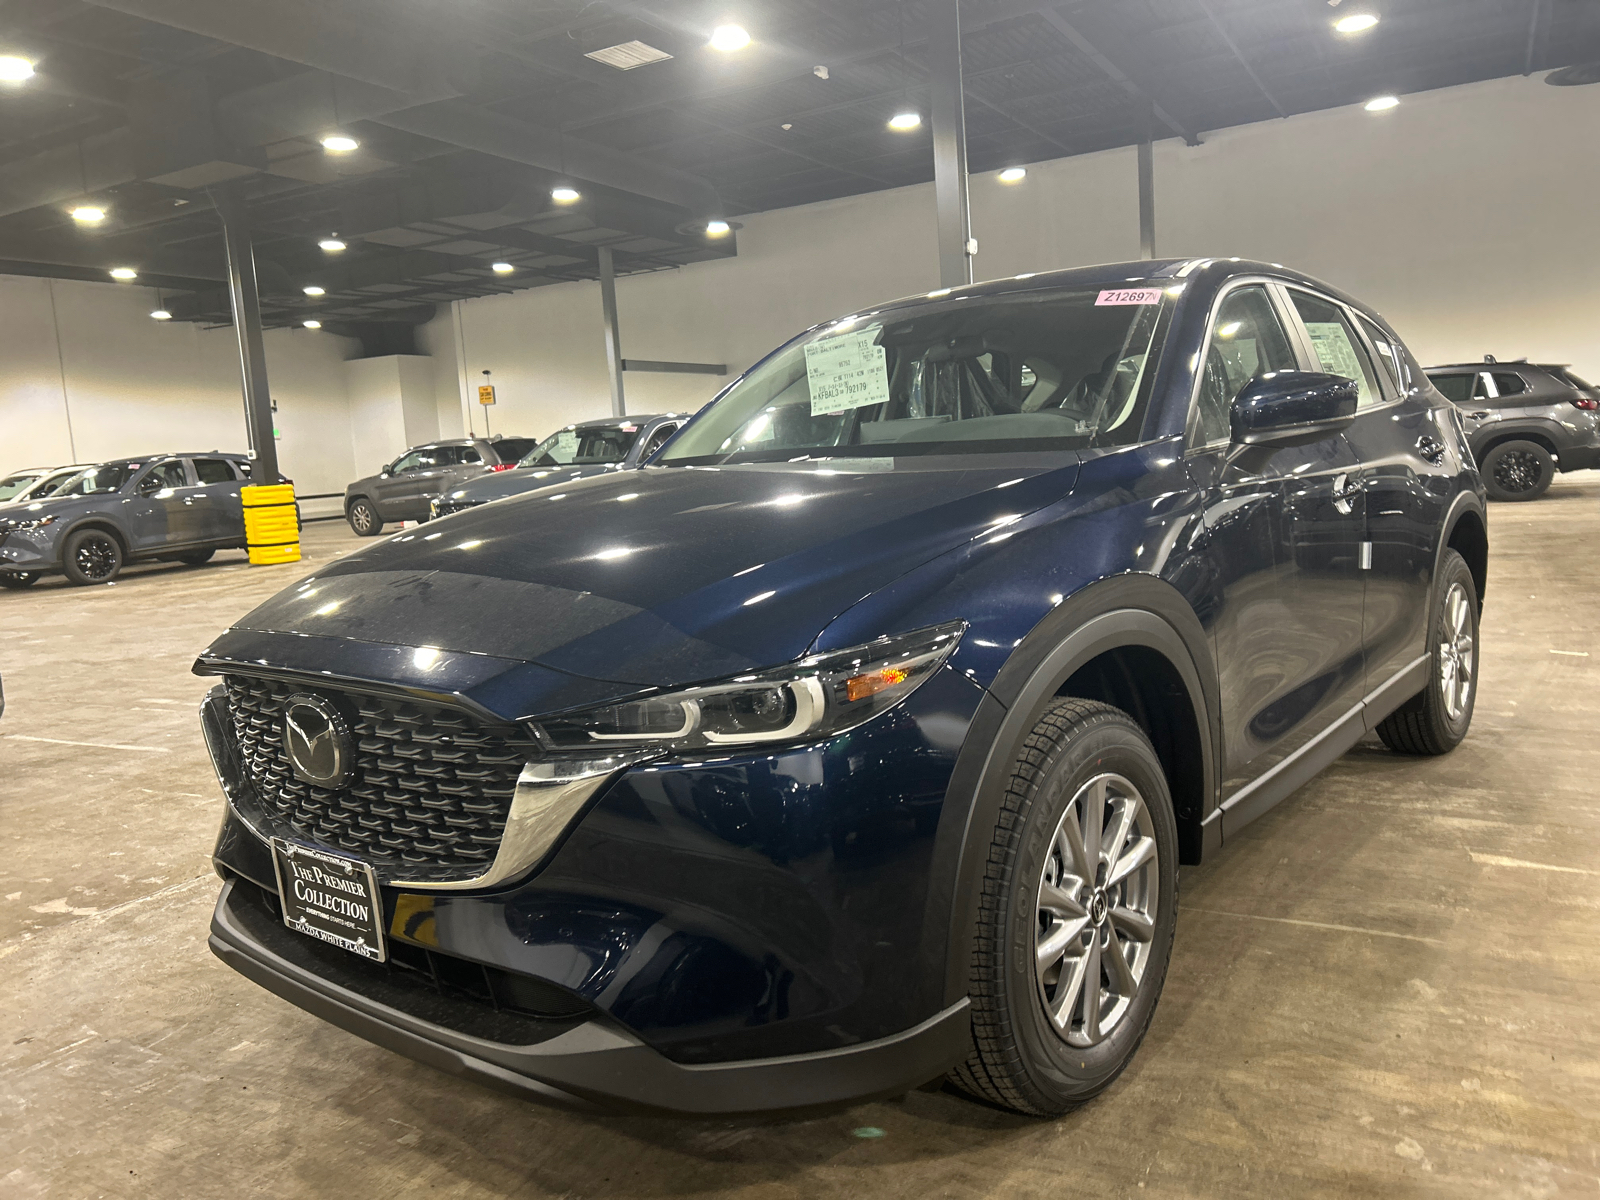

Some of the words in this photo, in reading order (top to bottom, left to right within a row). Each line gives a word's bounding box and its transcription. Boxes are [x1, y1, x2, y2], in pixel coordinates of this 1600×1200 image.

[845, 382, 867, 394] 792179
[291, 861, 315, 882] THE
[312, 866, 367, 898] PREMIER
[294, 879, 369, 922] COLLECTION
[296, 923, 320, 938] MAZDA
[320, 930, 344, 947] WHITE
[345, 941, 371, 957] PLAINS
